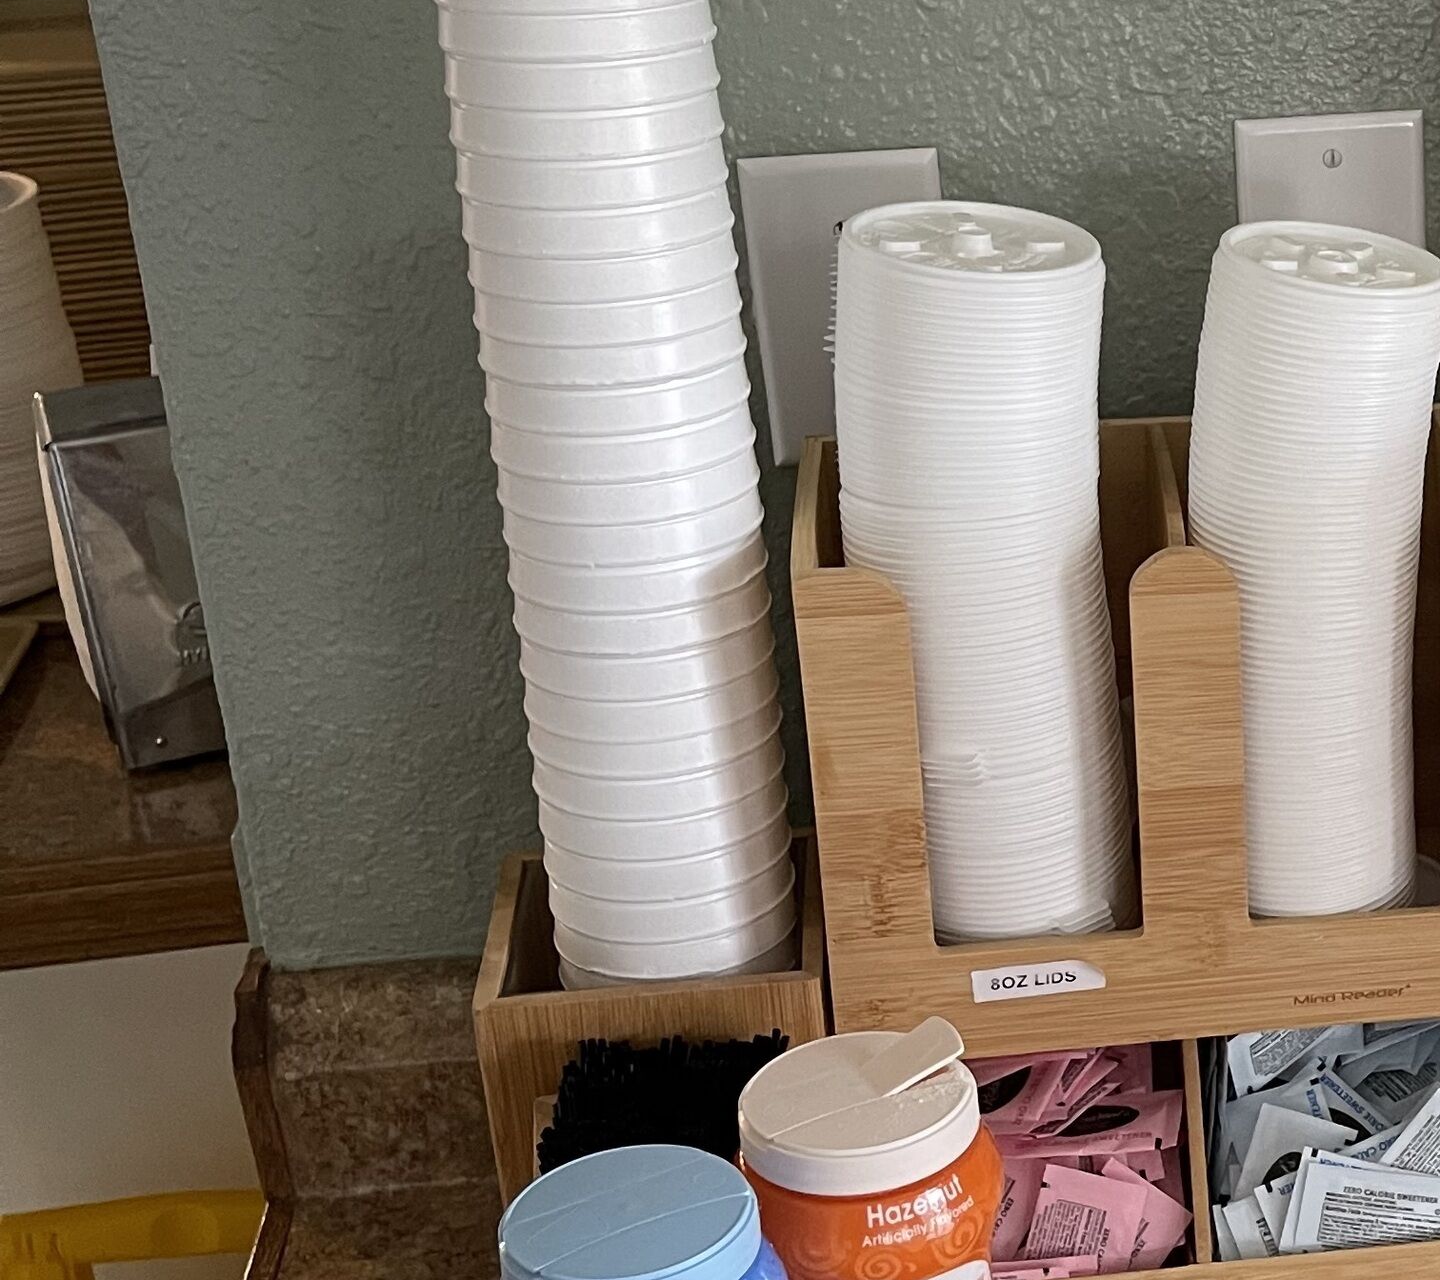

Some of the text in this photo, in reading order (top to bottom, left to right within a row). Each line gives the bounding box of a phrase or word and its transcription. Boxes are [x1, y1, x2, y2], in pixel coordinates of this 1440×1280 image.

[990, 971, 1077, 991] 8OZ LIDS
[1293, 987, 1405, 1005] Mind Reader
